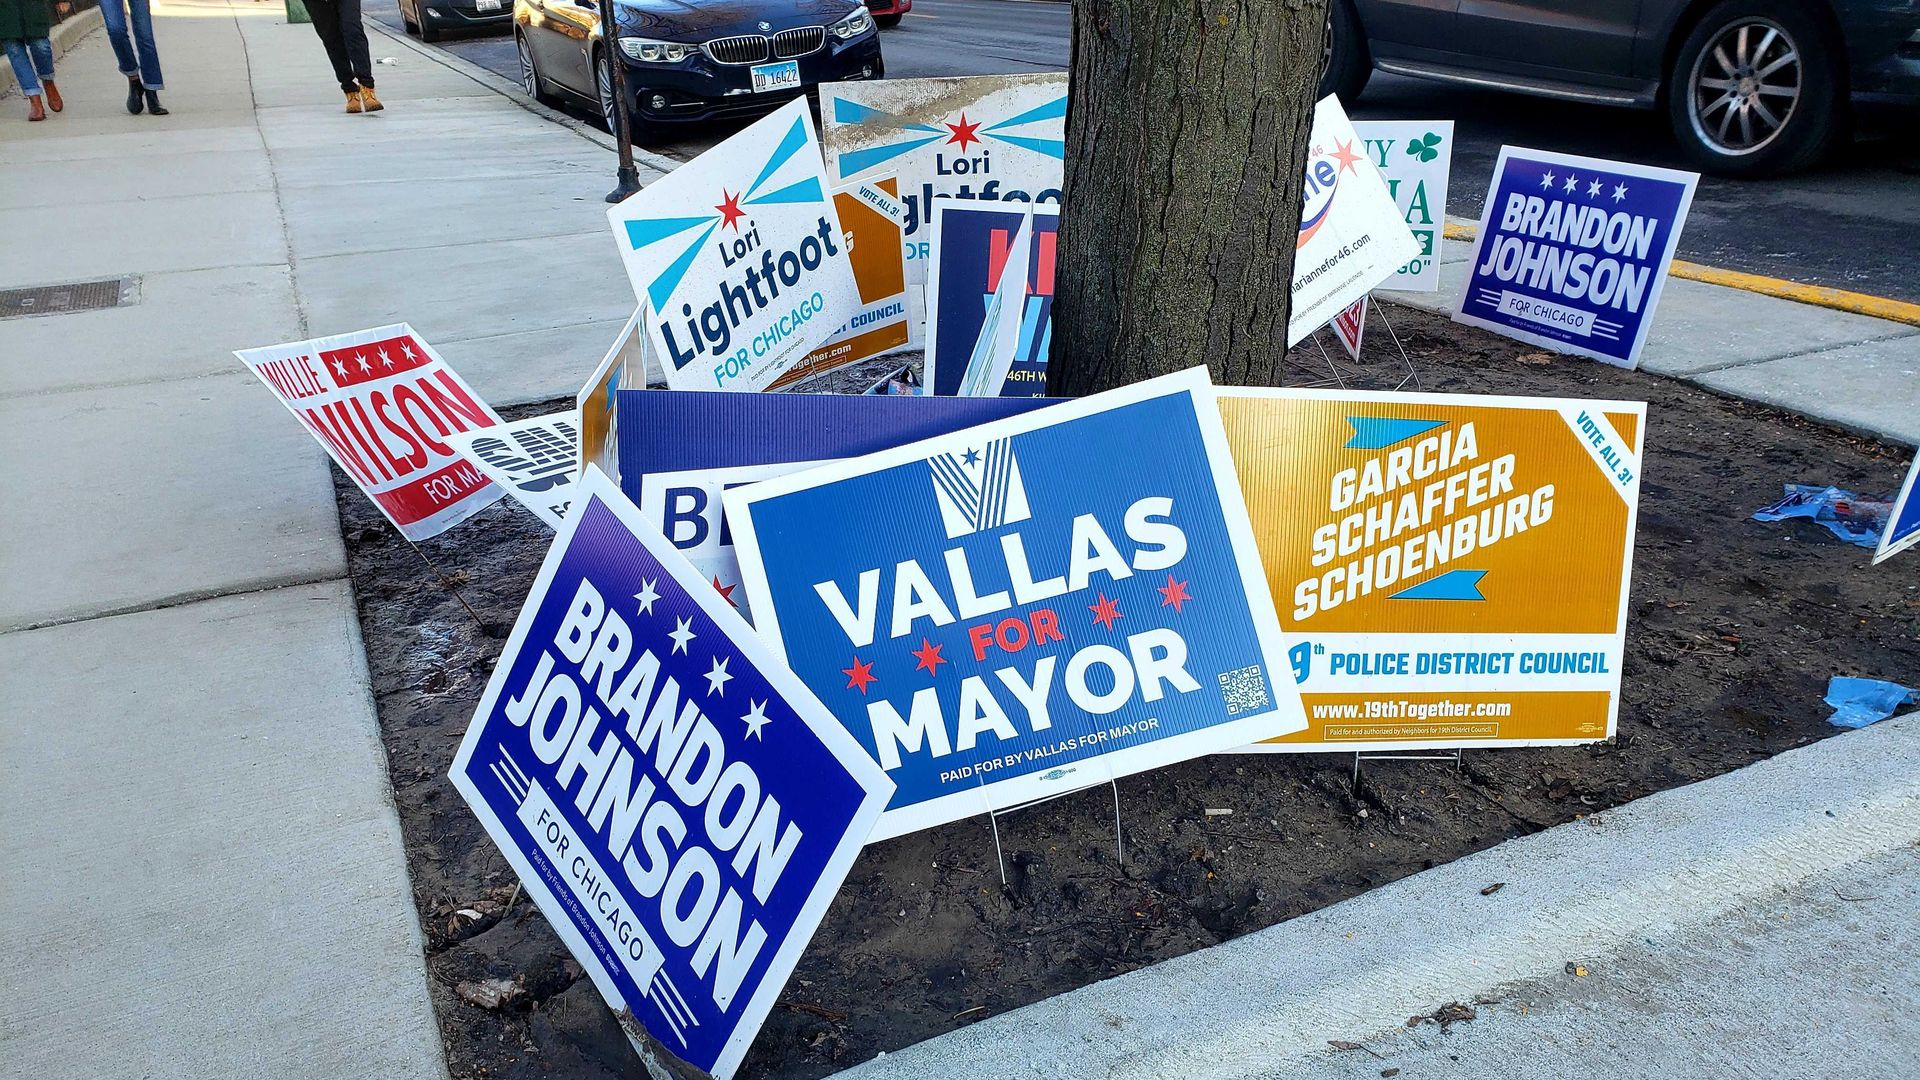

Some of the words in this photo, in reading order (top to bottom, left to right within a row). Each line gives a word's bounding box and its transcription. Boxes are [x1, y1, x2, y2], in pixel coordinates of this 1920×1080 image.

[937, 150, 990, 175] Lori
[859, 186, 878, 203] VOTE
[876, 199, 890, 212] ALL
[890, 207, 900, 217] 3!
[1500, 192, 1658, 260] BRANDON
[719, 221, 761, 268] Lori
[906, 242, 930, 260] OR
[1479, 235, 1651, 314] JOHNSON
[660, 216, 839, 371] Lightfoot
[851, 303, 905, 329] COUNCIL
[1509, 298, 1531, 313] FOR
[1533, 305, 1584, 327] CHICAGO
[714, 348, 751, 388] FOR
[752, 292, 824, 357] CHICAGO
[255, 354, 328, 401] WILLIE
[1007, 371, 1036, 382] 46TH
[294, 369, 497, 487] WILSON
[1577, 410, 1605, 448] VOTE
[1599, 445, 1621, 472] ALL
[1617, 467, 1633, 486] 3!
[423, 476, 460, 505] FOR
[1330, 421, 1478, 513] GARCIA
[1311, 453, 1516, 568] SCHAFFER
[813, 496, 1188, 648] VALLAS
[1293, 484, 1555, 622] SCHOENBURG
[968, 608, 1064, 662] FOR
[1330, 653, 1409, 675] POLICE
[1415, 652, 1514, 675] DISTRICT
[1519, 652, 1609, 674] COUNCIL
[866, 627, 1203, 771] MAYOR
[1312, 700, 1511, 720] www.19thTogether.com
[1393, 728, 1401, 736] by
[1401, 727, 1430, 736] Neighbors
[1438, 726, 1450, 734] 19th
[554, 577, 803, 906] BRANDON
[940, 767, 972, 784] PAID
[974, 759, 1003, 774] FOR
[1005, 752, 1023, 767] BY
[1023, 739, 1077, 761] VALLAS
[1079, 731, 1108, 747] FOR
[1109, 718, 1159, 739] MAYOR
[504, 650, 769, 1014] JOHNSON
[531, 848, 542, 865] Paid
[540, 862, 548, 873] for
[546, 871, 553, 881] by
[551, 876, 568, 901] Friends
[567, 898, 574, 907] of
[571, 903, 590, 932] Brandon
[588, 928, 606, 955] Johnson
[537, 808, 570, 859] FOR
[571, 855, 644, 962] CHICAGO
